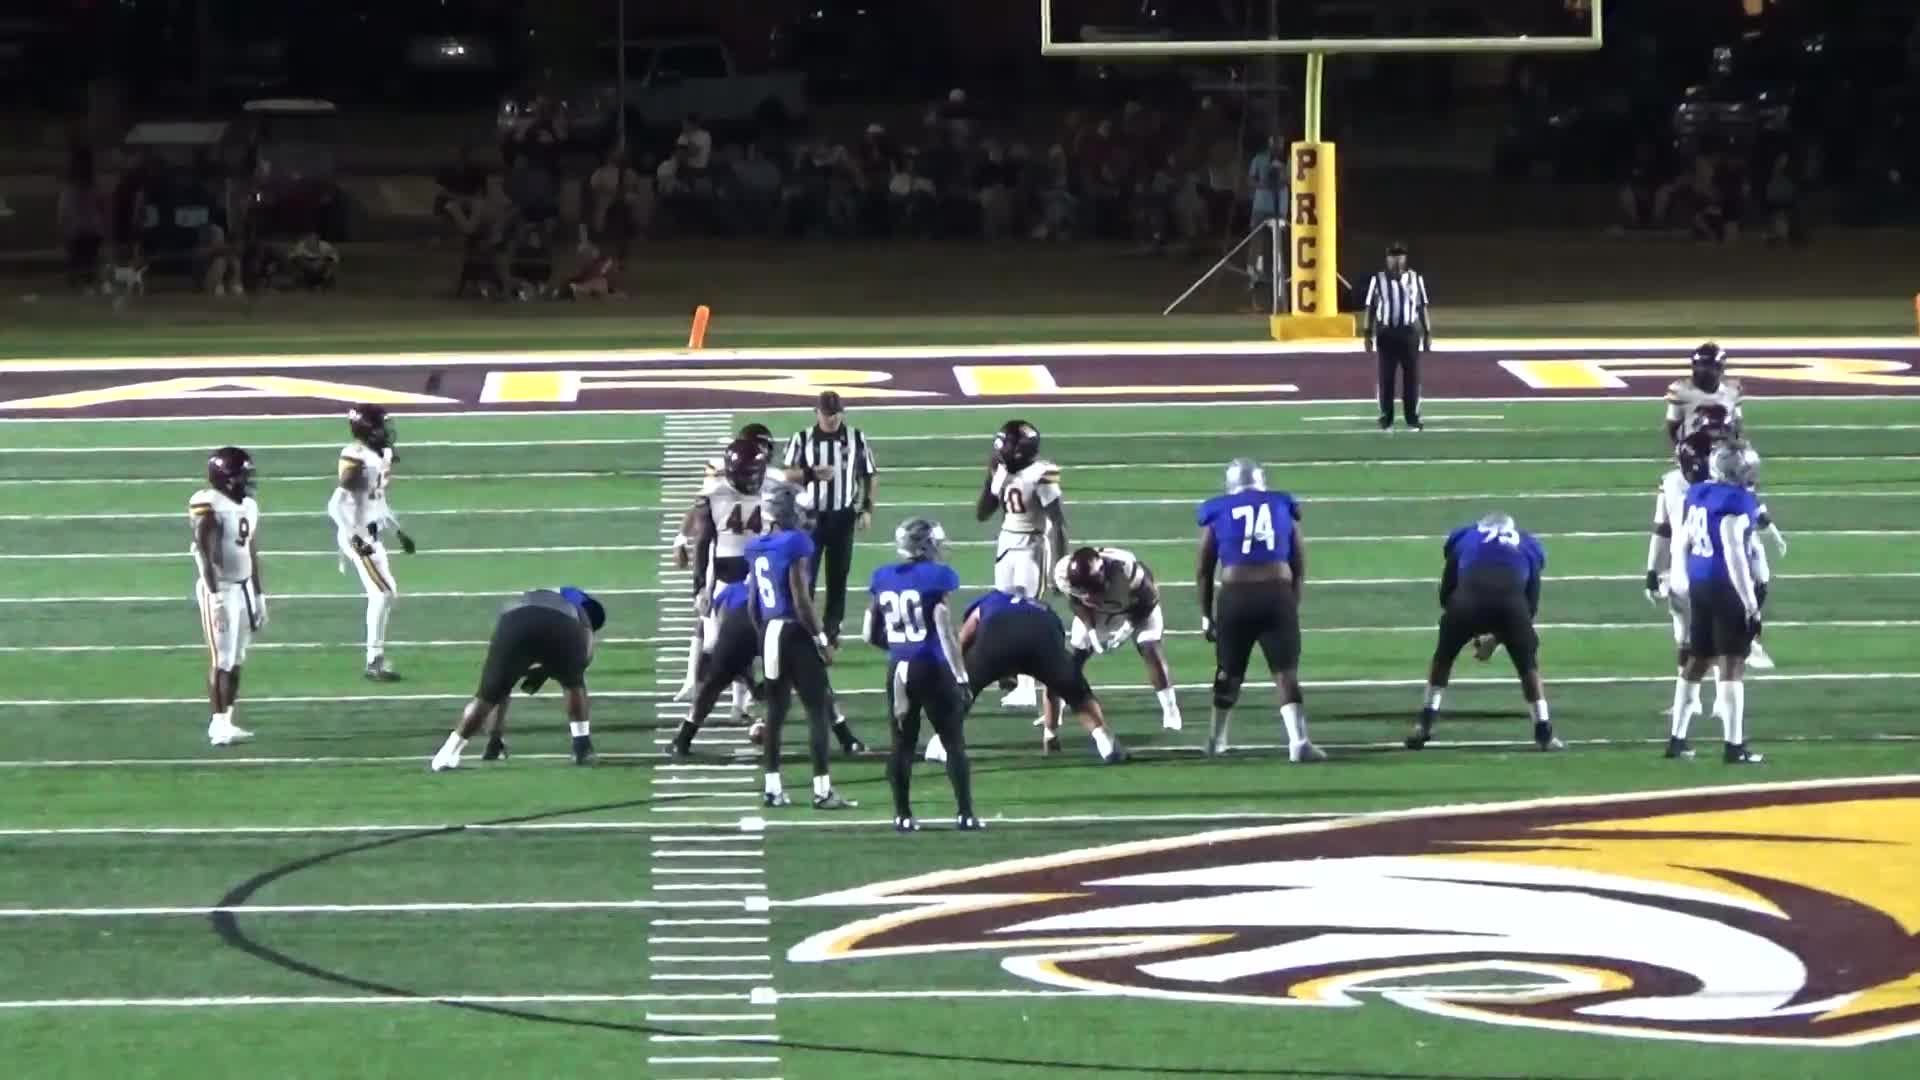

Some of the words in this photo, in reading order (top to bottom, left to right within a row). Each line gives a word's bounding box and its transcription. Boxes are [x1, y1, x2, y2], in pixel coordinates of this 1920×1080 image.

[1296, 148, 1318, 313] PRCC
[236, 517, 250, 547] 9
[721, 503, 763, 535] 44
[1231, 503, 1275, 554] 74
[755, 556, 776, 608] 6
[879, 589, 927, 643] 20
